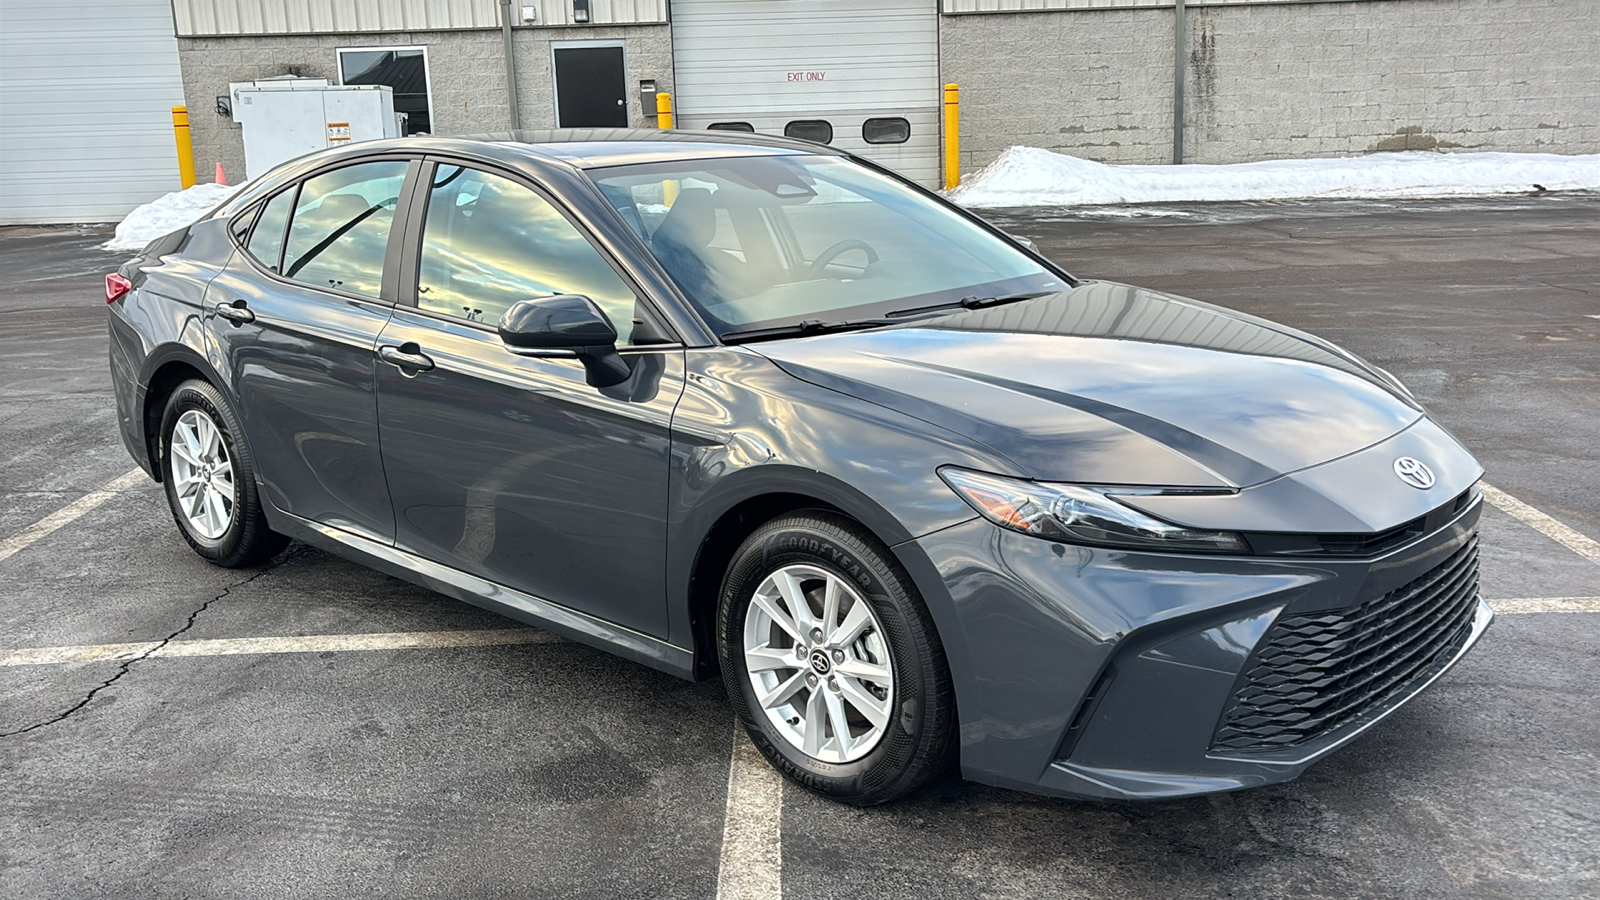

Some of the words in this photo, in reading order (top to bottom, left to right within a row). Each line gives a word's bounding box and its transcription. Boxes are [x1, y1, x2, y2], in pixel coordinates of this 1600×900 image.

[787, 72, 803, 81] EXIT
[806, 71, 825, 81] ONLY
[779, 536, 871, 588] GOODYEAR
